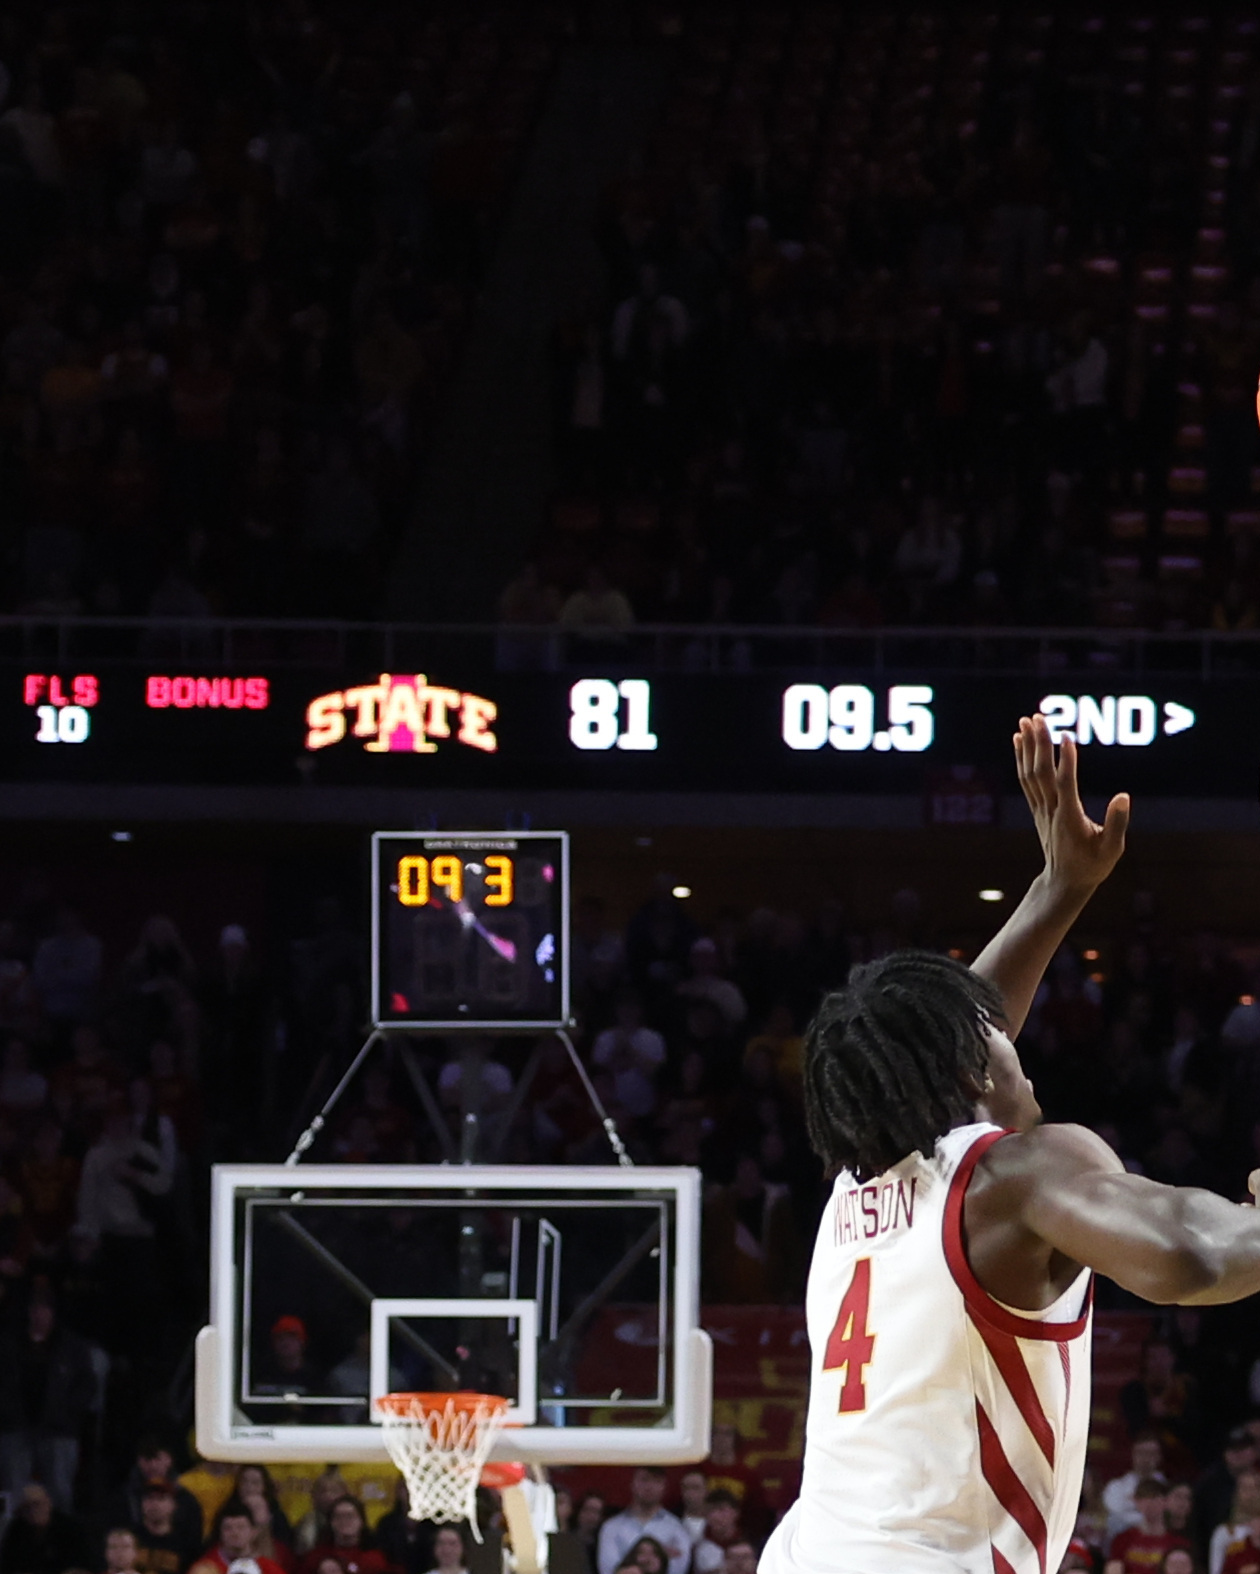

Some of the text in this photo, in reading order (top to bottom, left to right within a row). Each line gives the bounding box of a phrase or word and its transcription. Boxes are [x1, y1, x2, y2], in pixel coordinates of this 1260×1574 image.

[24, 674, 99, 707] FLS
[146, 676, 269, 709] BONUS
[305, 682, 498, 753] STATE
[569, 679, 657, 750] 81
[783, 684, 934, 751] 09.5
[36, 706, 89, 743] 10
[822, 1256, 878, 1417] 4
